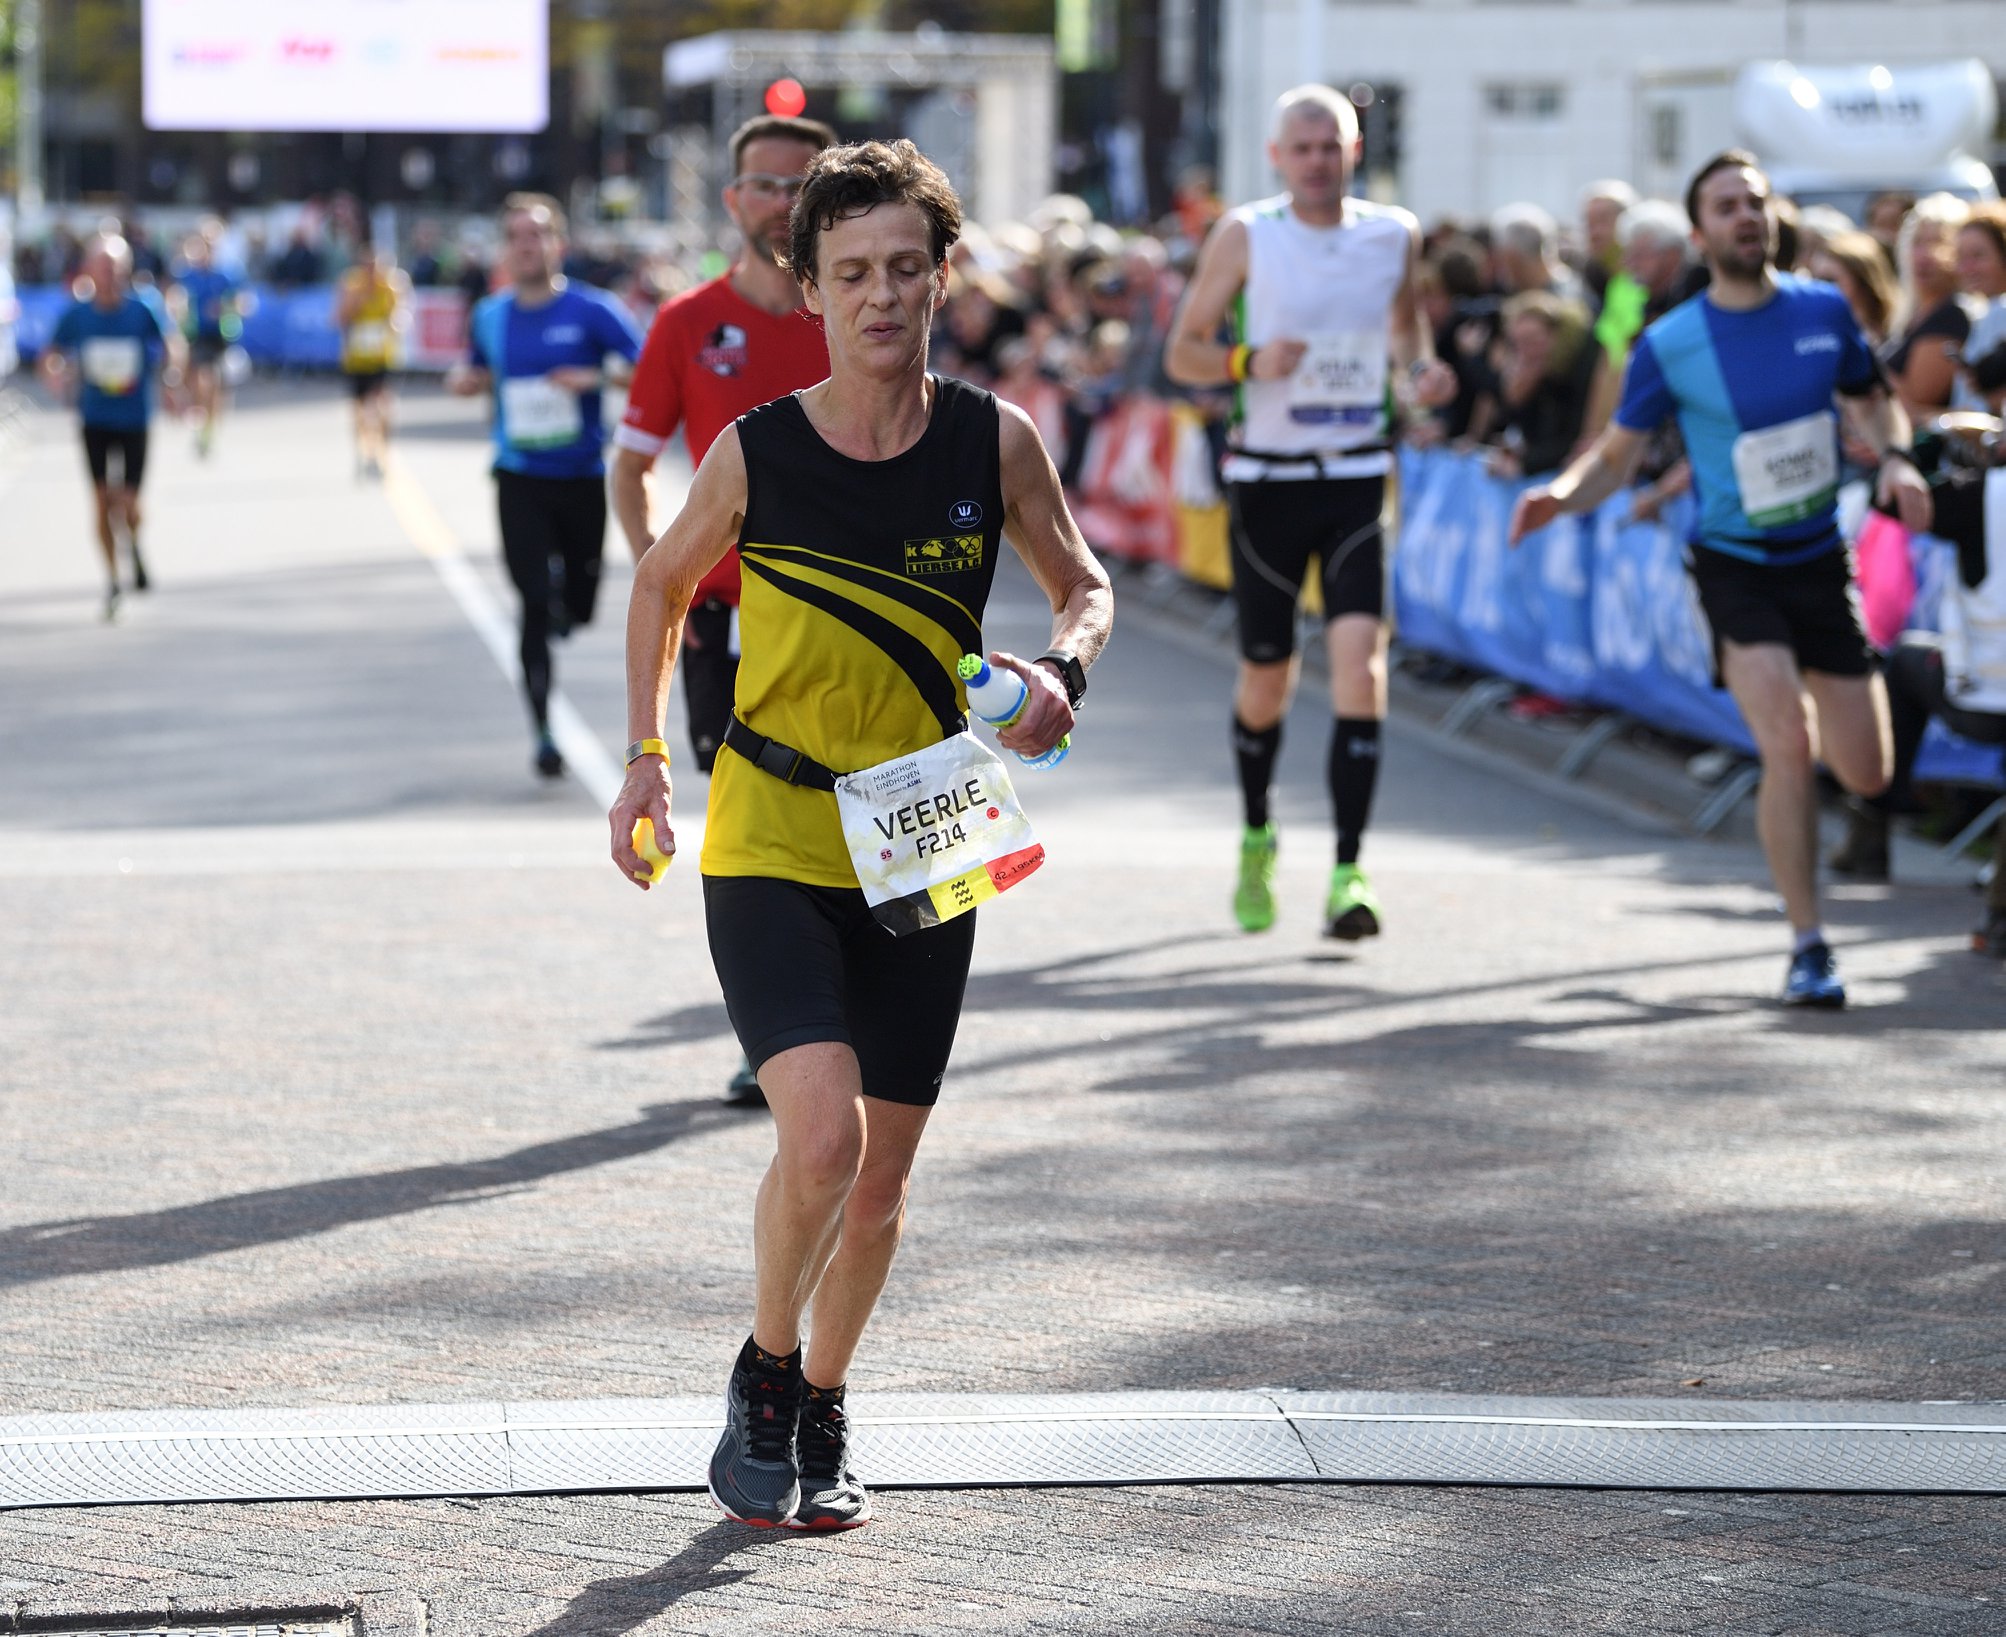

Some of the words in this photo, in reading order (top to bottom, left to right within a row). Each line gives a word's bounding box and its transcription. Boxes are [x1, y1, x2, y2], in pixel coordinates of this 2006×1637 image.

[908, 561, 960, 574] LIERSE
[873, 761, 917, 782] MARATHON
[875, 769, 920, 791] EINDHOVEN
[907, 778, 922, 789] ASML
[873, 779, 987, 840] VEERLE
[916, 822, 967, 859] F214
[880, 849, 893, 860] 55
